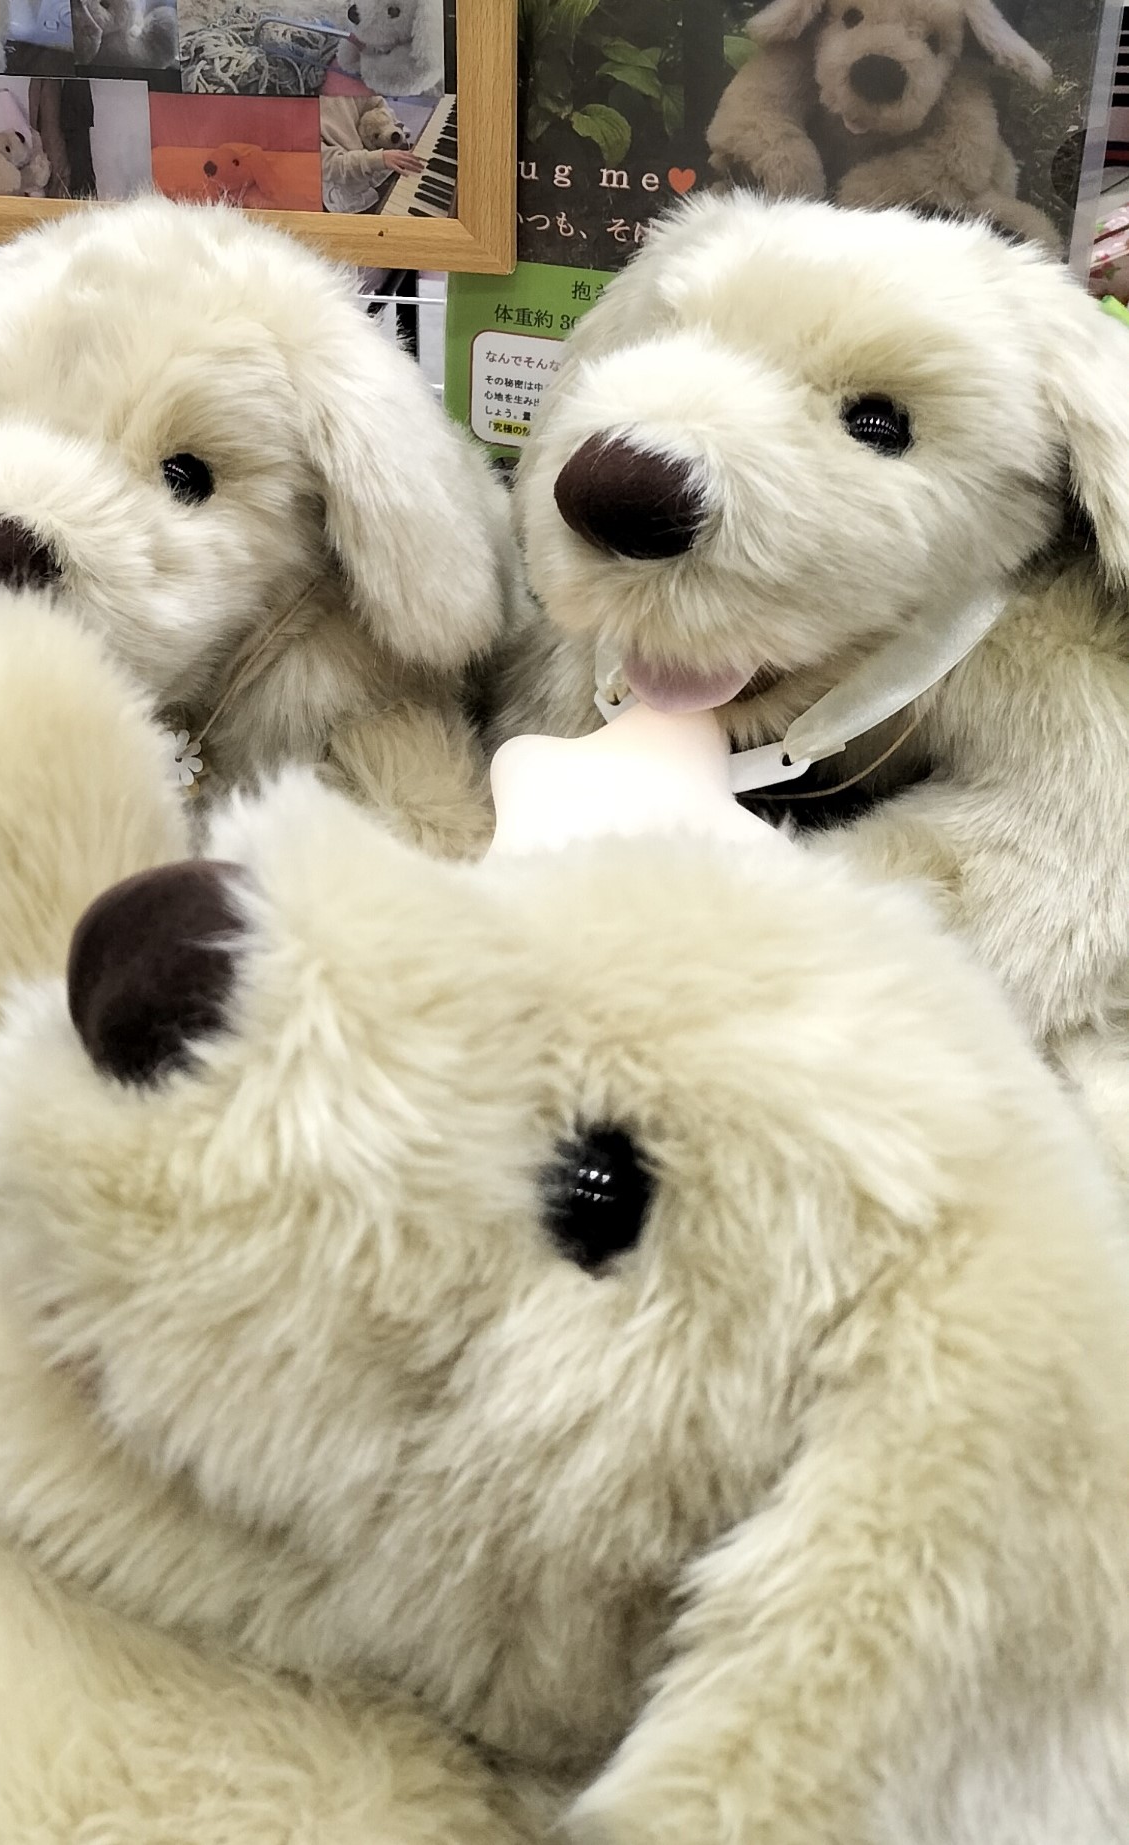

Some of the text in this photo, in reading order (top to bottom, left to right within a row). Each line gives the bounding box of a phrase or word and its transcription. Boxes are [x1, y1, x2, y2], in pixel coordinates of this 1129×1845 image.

[599, 167, 660, 192] me
[485, 351, 561, 372] なんでそんな
